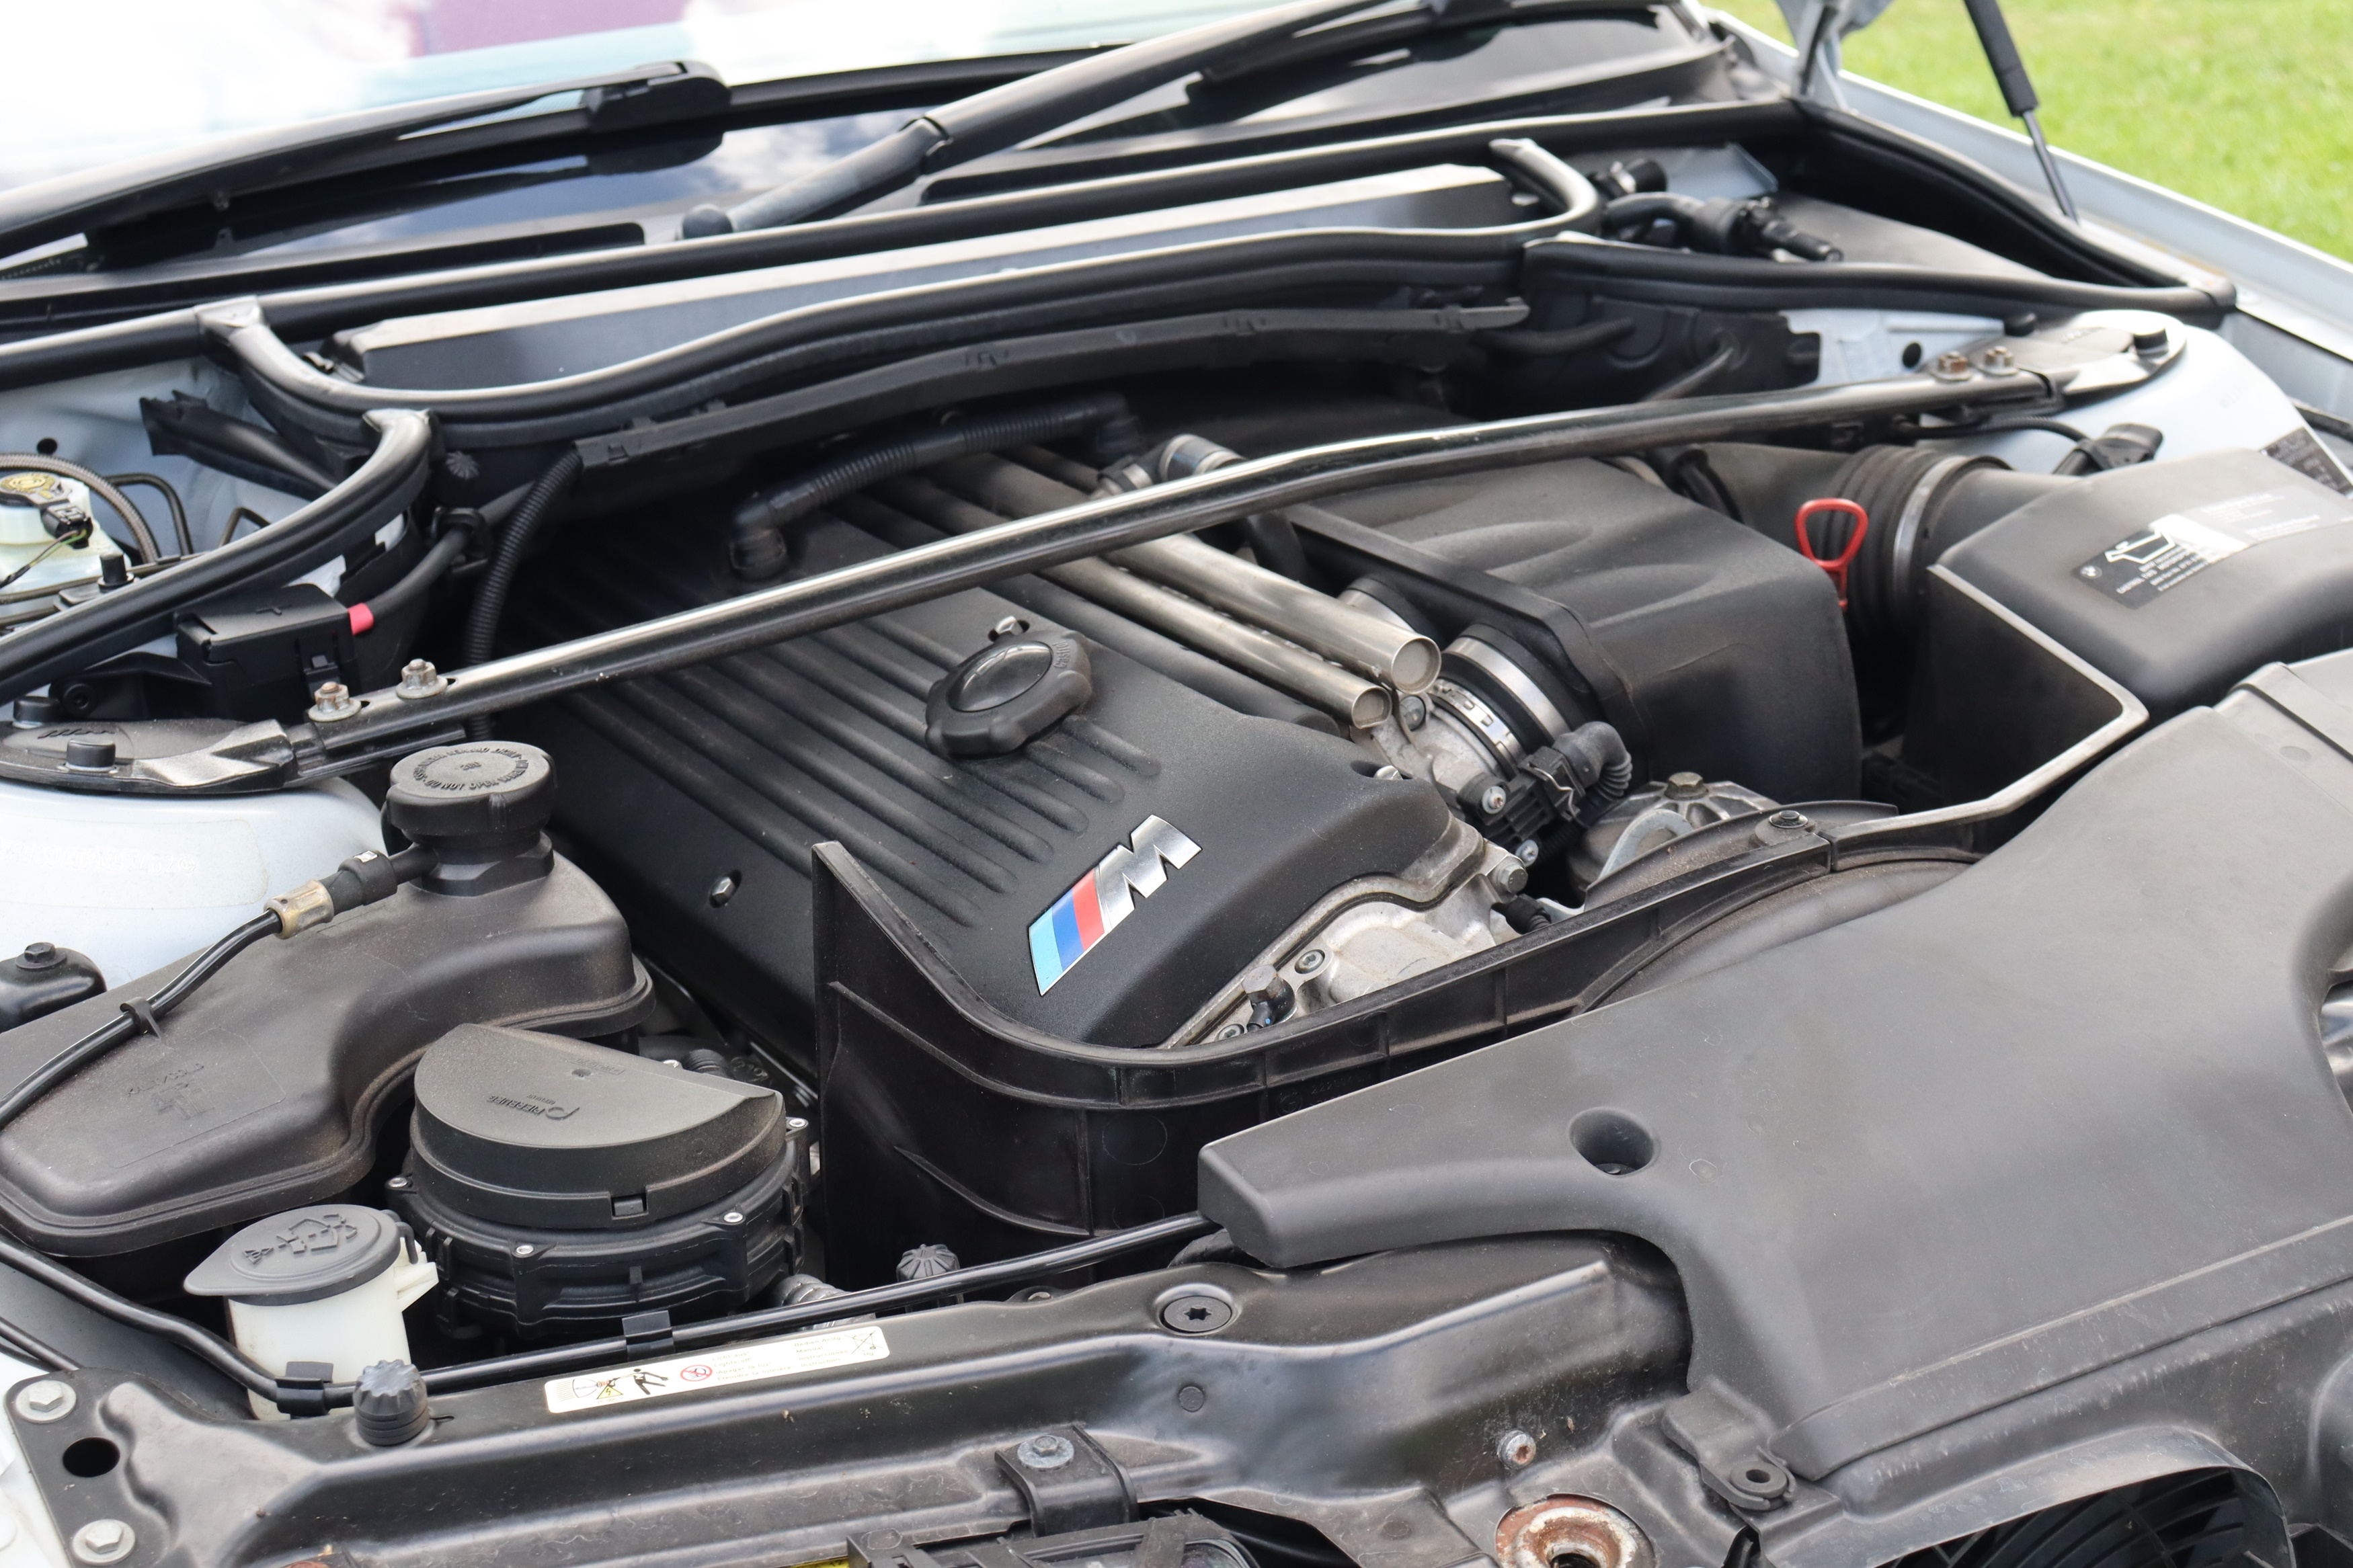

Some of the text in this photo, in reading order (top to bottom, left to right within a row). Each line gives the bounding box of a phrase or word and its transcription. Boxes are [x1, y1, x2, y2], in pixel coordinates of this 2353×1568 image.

[1053, 640, 1071, 670] Castrol
[441, 782, 465, 791] NOT
[469, 779, 500, 790] OPEN
[486, 1094, 547, 1116] PIERBURG
[796, 1346, 824, 1354] Manual
[799, 1350, 848, 1362] Instrucciones
[714, 1359, 738, 1368] Lights
[801, 1358, 841, 1368] Instruction
